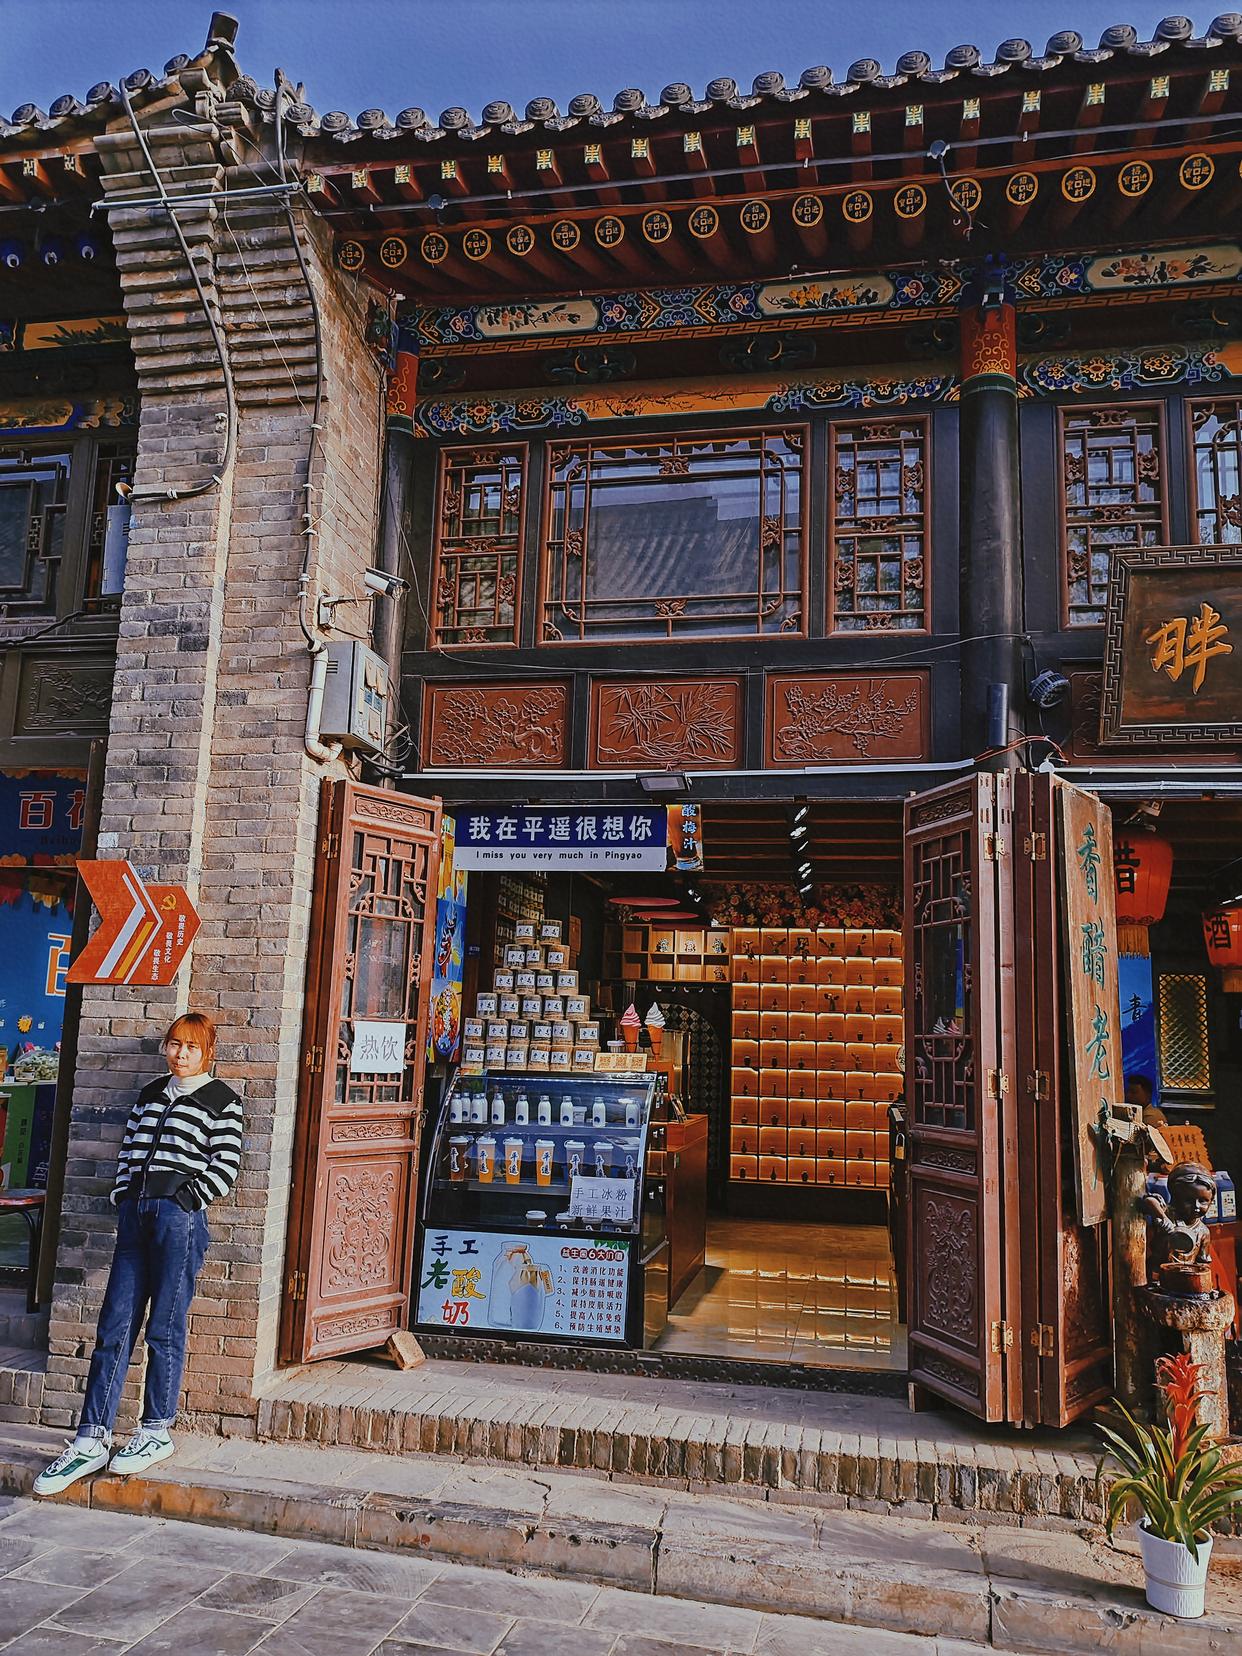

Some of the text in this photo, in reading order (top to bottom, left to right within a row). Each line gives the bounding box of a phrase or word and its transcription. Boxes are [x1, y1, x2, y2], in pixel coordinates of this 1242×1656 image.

[468, 815, 653, 841] 我在平遥很想你
[482, 851, 504, 859] miss
[510, 853, 527, 861] you
[532, 853, 553, 861] very
[558, 851, 584, 859] much
[590, 851, 599, 859] in
[605, 851, 643, 861] Pingyao
[1206, 911, 1231, 950] 酒
[360, 1034, 398, 1061] 热饮
[575, 1187, 627, 1201] 手工冰粉
[571, 1204, 627, 1218] 新鲜果汁
[431, 1235, 479, 1257] 手工
